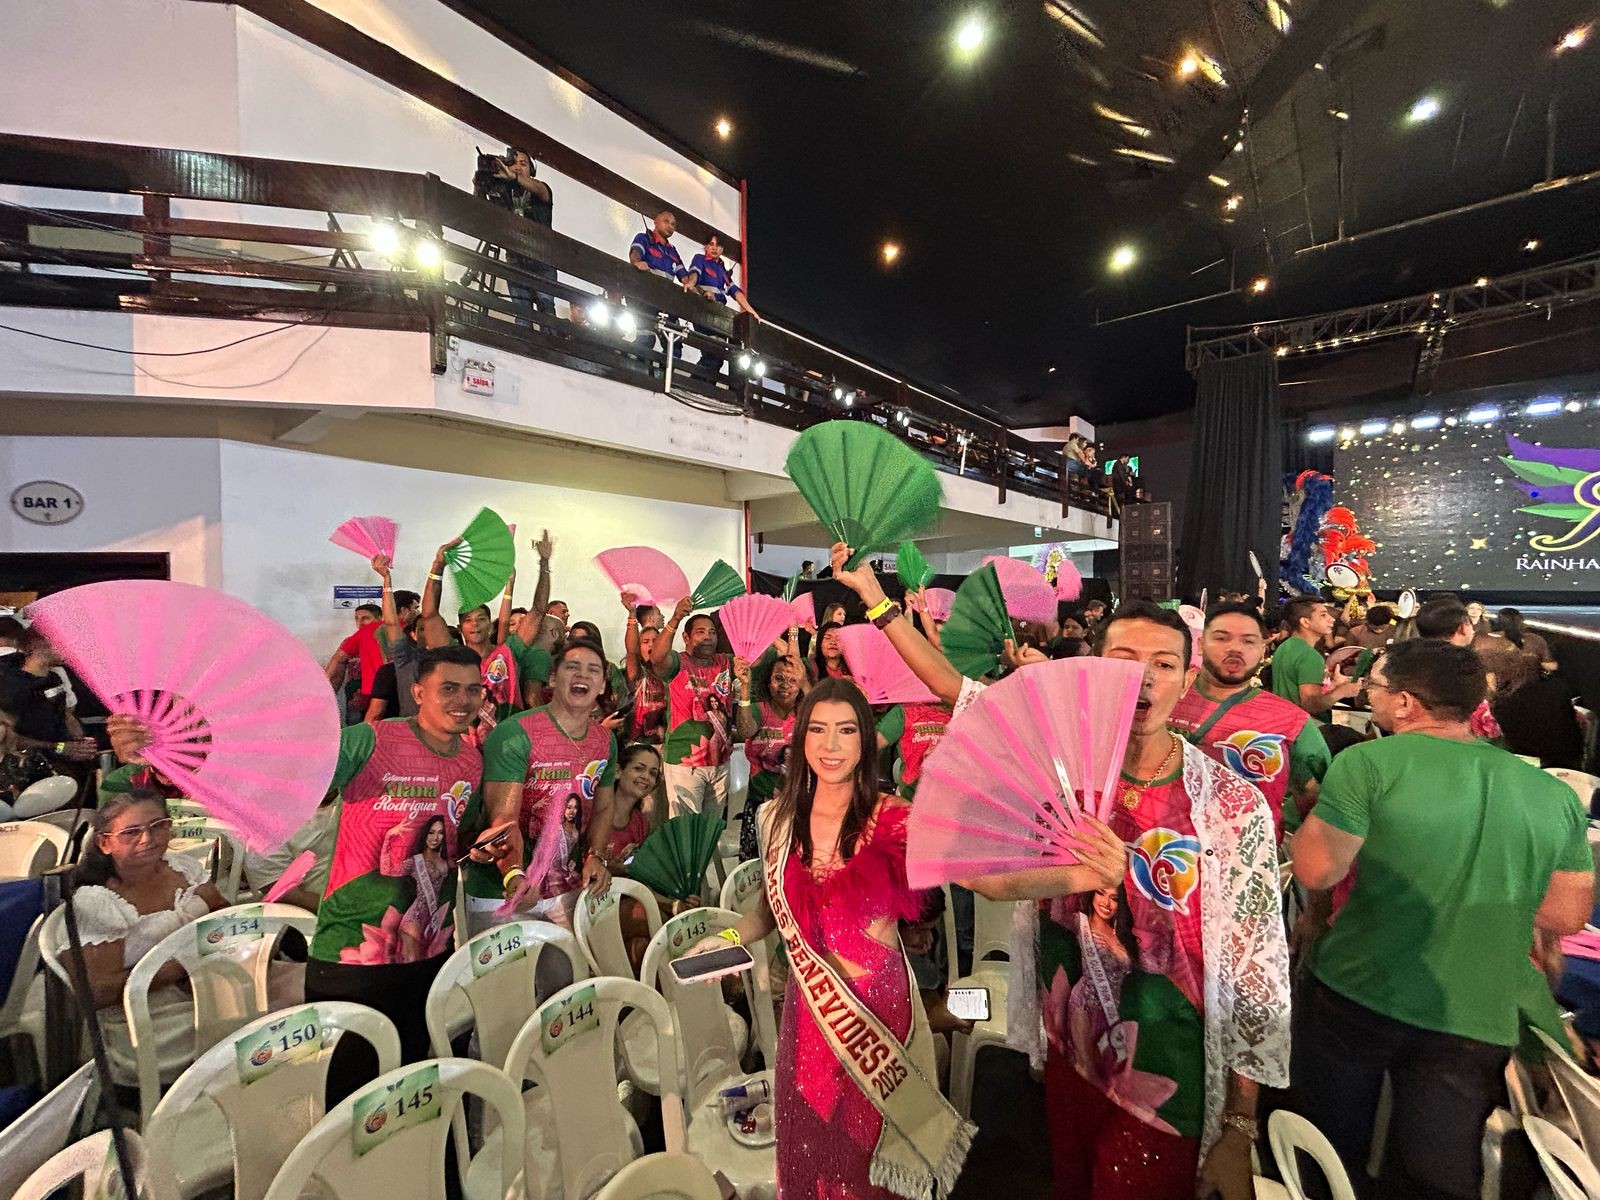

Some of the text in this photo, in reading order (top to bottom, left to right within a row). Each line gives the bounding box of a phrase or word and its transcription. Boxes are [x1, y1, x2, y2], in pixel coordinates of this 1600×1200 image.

[23, 497, 72, 509] BAR 1
[1516, 558, 1600, 570] RAINHA
[373, 795, 438, 819] Rodrigues
[182, 826, 203, 838] 160
[229, 918, 259, 936] 154
[686, 921, 707, 940] 143
[495, 935, 521, 957] 148
[767, 864, 889, 1075] MISS BENEVIDES
[566, 1001, 594, 1027] 144
[279, 1023, 317, 1053] 150
[871, 1057, 909, 1101] 2025
[394, 1083, 433, 1118] 145
